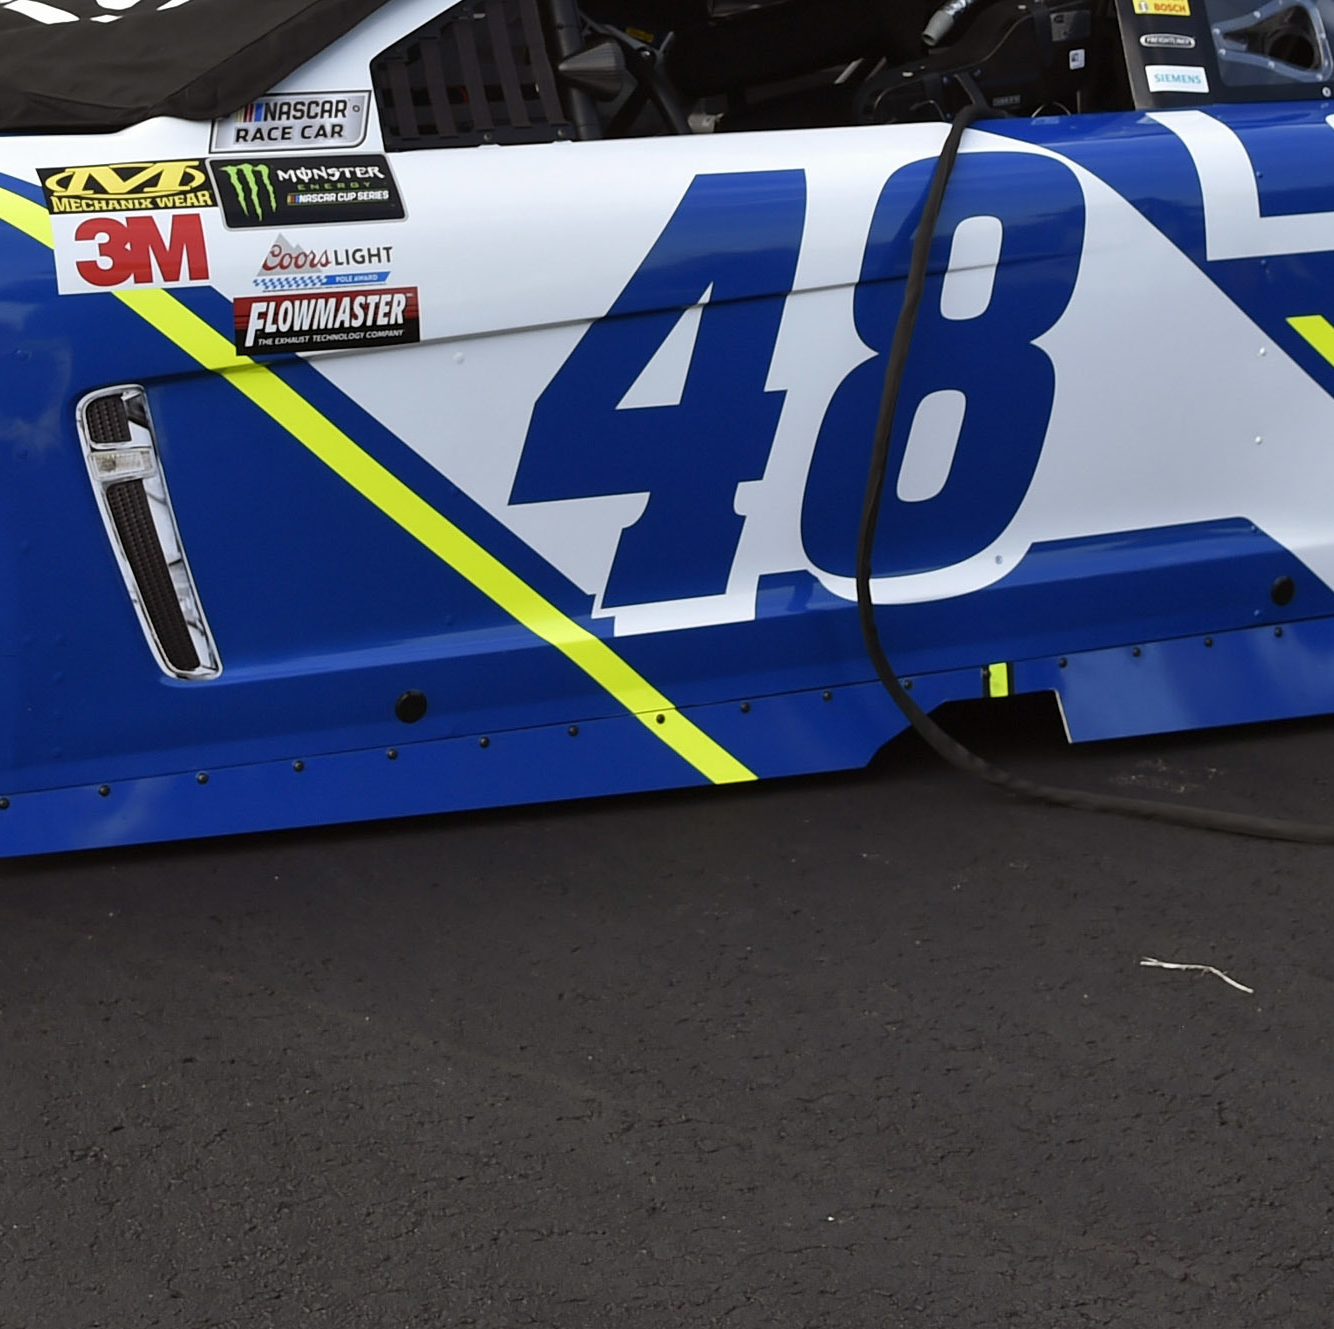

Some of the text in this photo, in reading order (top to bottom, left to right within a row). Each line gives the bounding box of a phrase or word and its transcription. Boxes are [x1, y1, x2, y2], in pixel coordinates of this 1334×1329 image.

[1154, 3, 1186, 13] BOSCH
[1154, 74, 1202, 85] SIEMENS
[263, 99, 348, 122] NASCAR
[235, 124, 344, 143] RACE CAR
[277, 165, 386, 183] MONSTER
[297, 182, 371, 191] ENERGY
[50, 190, 213, 213] MECHANIX WEAR
[299, 190, 389, 203] NASCAR CUP SERIES
[74, 213, 210, 287] 3M
[261, 243, 393, 272] Coors LIGHT
[335, 275, 353, 283] POLE
[244, 292, 407, 348] FLOWMASTER
[258, 329, 405, 346] THE EXHAUST TECHNOLOGY COMPANY
[507, 151, 1086, 609] 48
